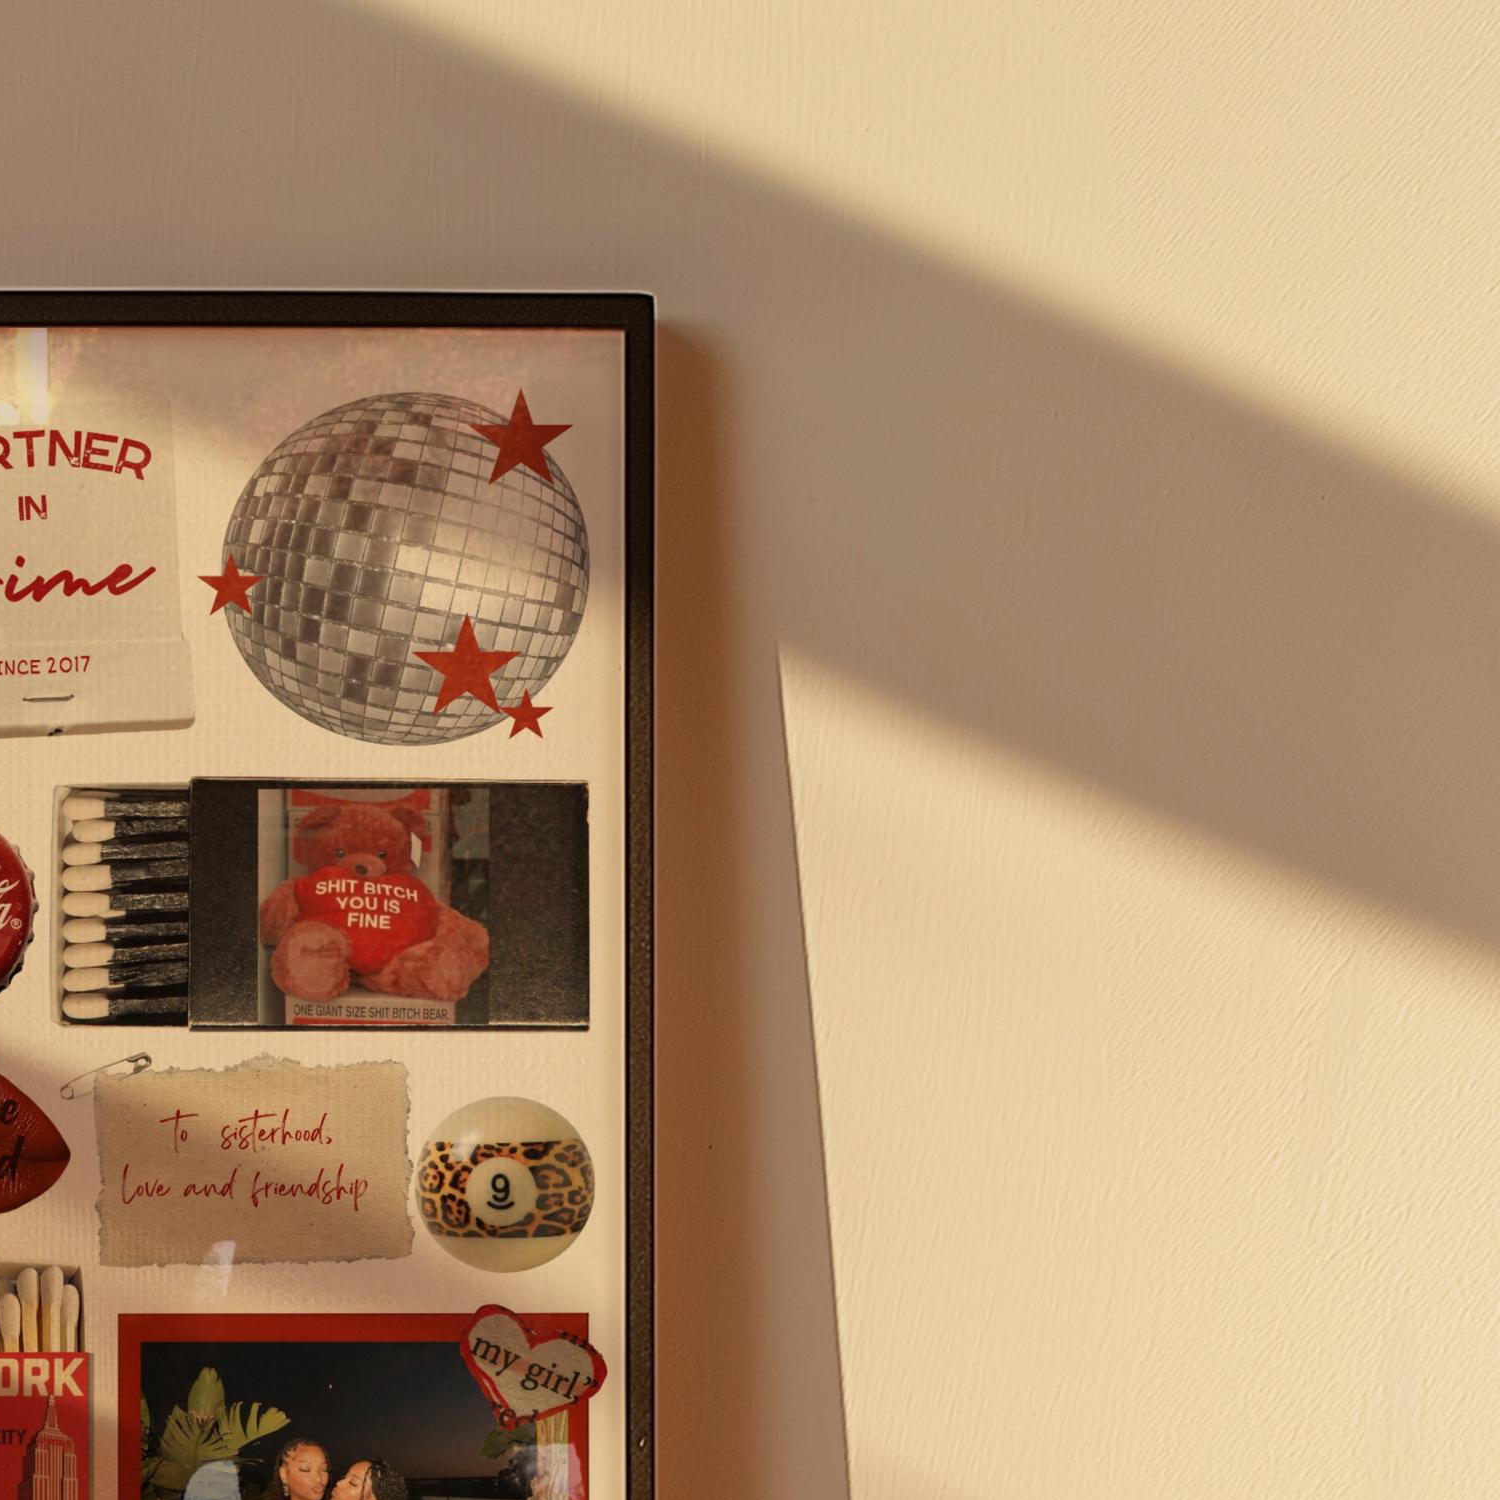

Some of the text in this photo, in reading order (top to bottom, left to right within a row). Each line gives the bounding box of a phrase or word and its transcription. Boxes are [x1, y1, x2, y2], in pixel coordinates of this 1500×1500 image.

[18, 495, 48, 521] IN
[47, 656, 91, 674] 2017
[315, 879, 418, 902] SHIT BITCH
[336, 896, 401, 914] YOU IS
[347, 912, 391, 930] FINE
[293, 1004, 450, 1020] ONE GIANT SIZE SHIT BITCH BEAR.
[220, 1108, 333, 1153] sisterhood,
[183, 1168, 238, 1200] and
[250, 1163, 368, 1211] friendship
[491, 1173, 510, 1203] 9
[471, 1337, 521, 1377] my
